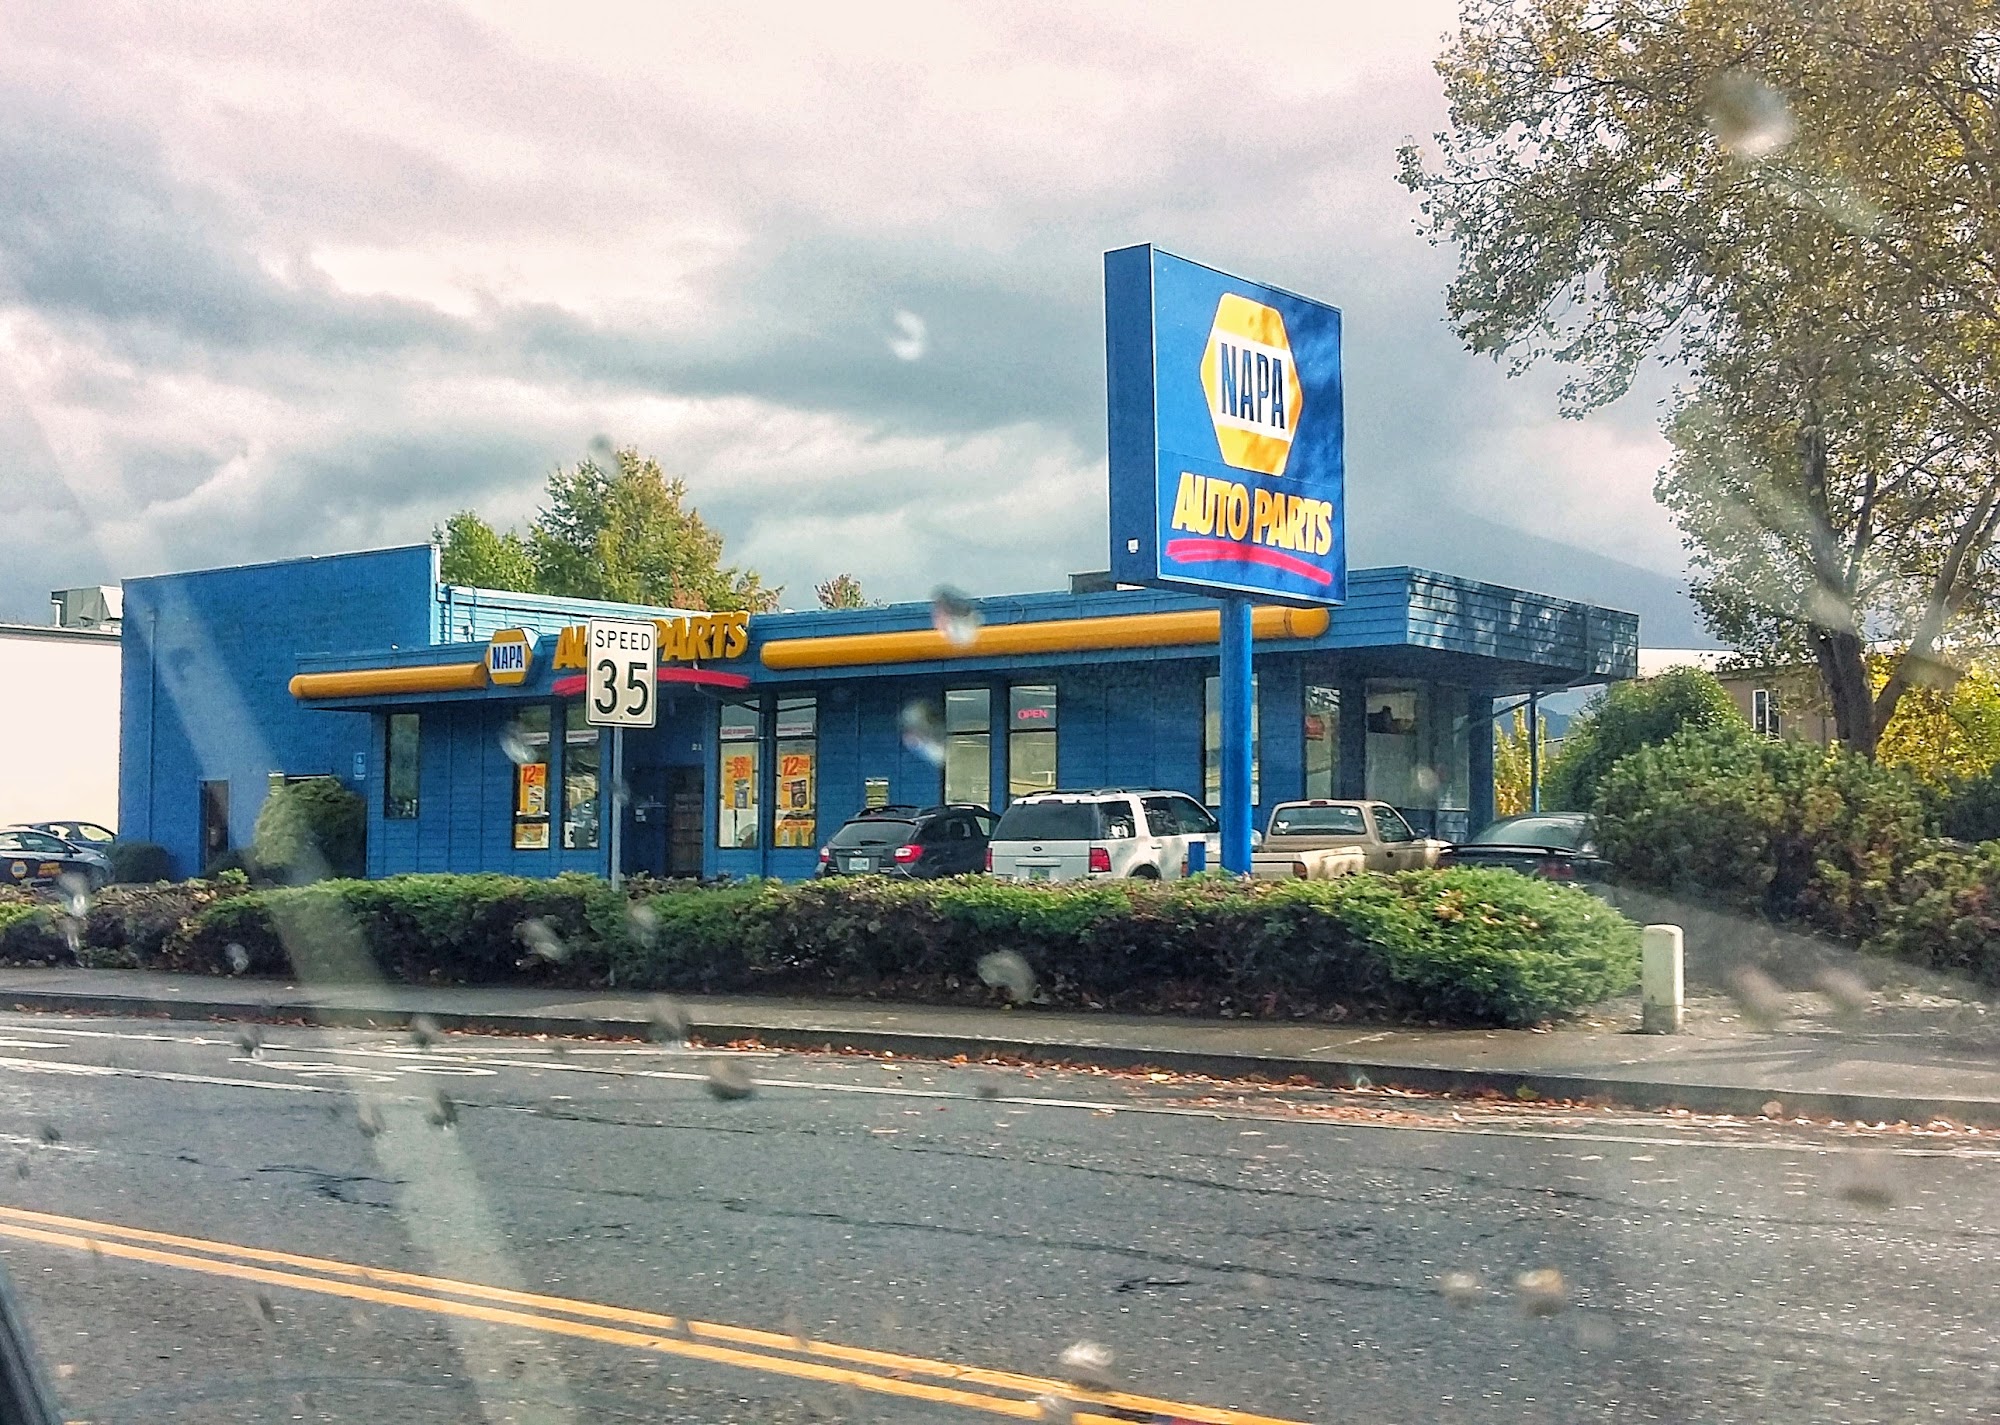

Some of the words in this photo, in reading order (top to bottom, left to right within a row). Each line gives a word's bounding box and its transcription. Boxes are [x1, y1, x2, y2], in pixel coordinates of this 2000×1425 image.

[1220, 342, 1286, 429] NAPA
[1171, 471, 1250, 541] AUTO
[1252, 488, 1333, 556] PARTS
[492, 645, 523, 670] NAPA
[552, 625, 588, 670] AU
[595, 629, 651, 651] SPEED
[594, 659, 648, 716] 35
[1017, 709, 1048, 719] OPEN
